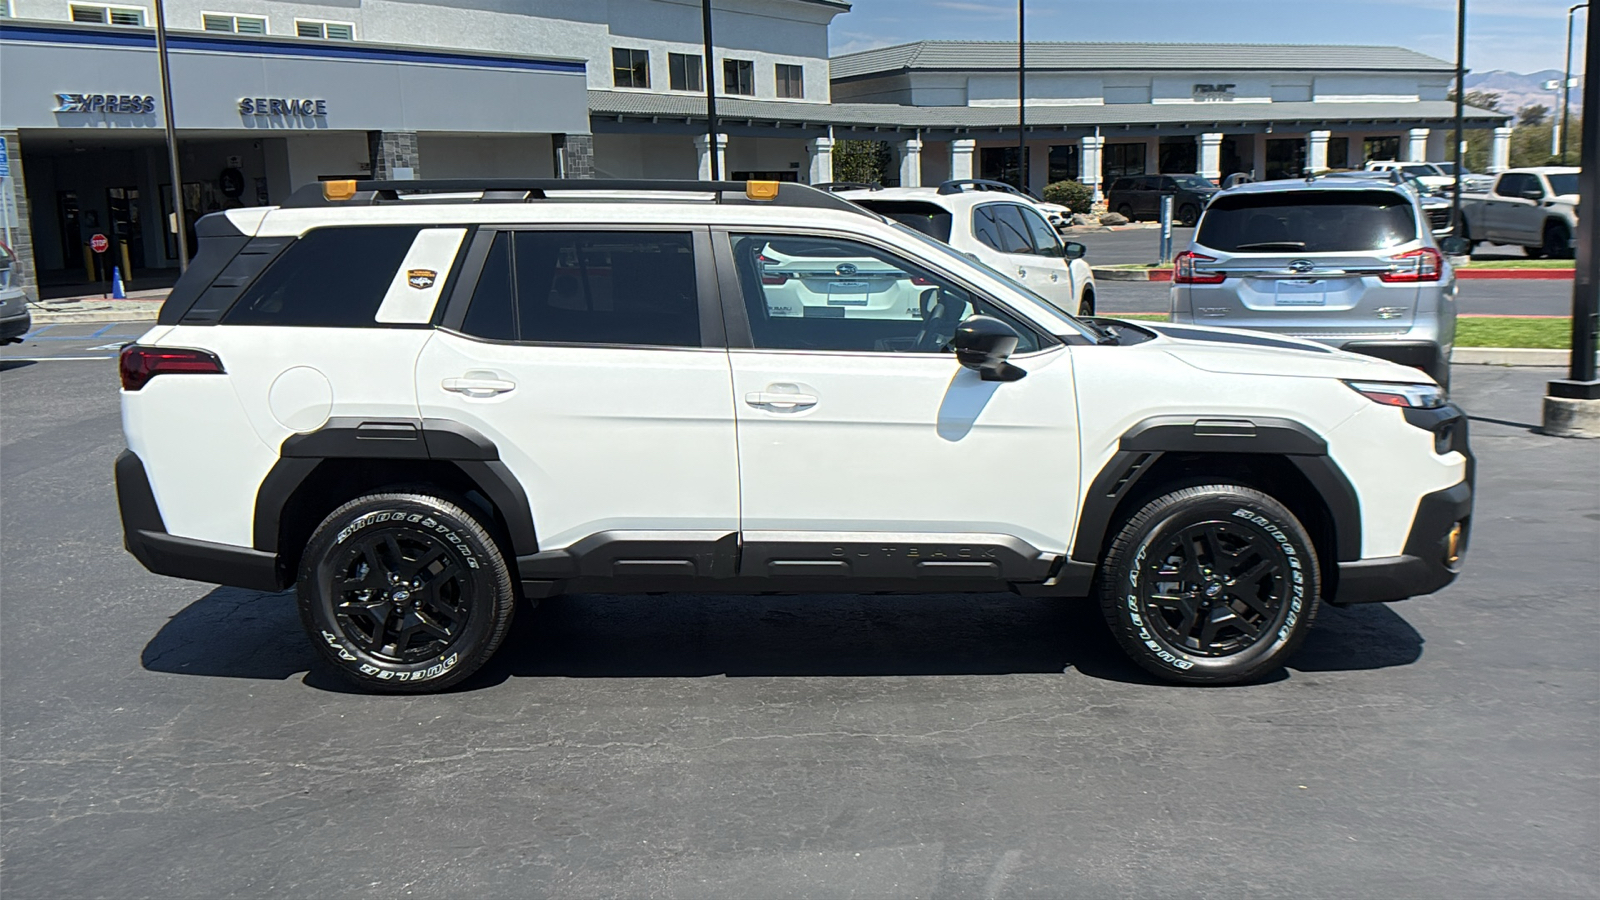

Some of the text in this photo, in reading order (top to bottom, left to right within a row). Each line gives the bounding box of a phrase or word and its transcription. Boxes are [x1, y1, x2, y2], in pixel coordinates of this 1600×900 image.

[53, 94, 327, 115] EXPRESS SERVICE
[91, 239, 107, 247] STOP
[337, 512, 480, 570] BRIDGESTONE
[831, 547, 996, 557] OUTBACK
[1232, 508, 1304, 641] BRIDGESTONE
[1127, 545, 1194, 670] DUELER A/T
[321, 630, 458, 681] DUELER A/T
